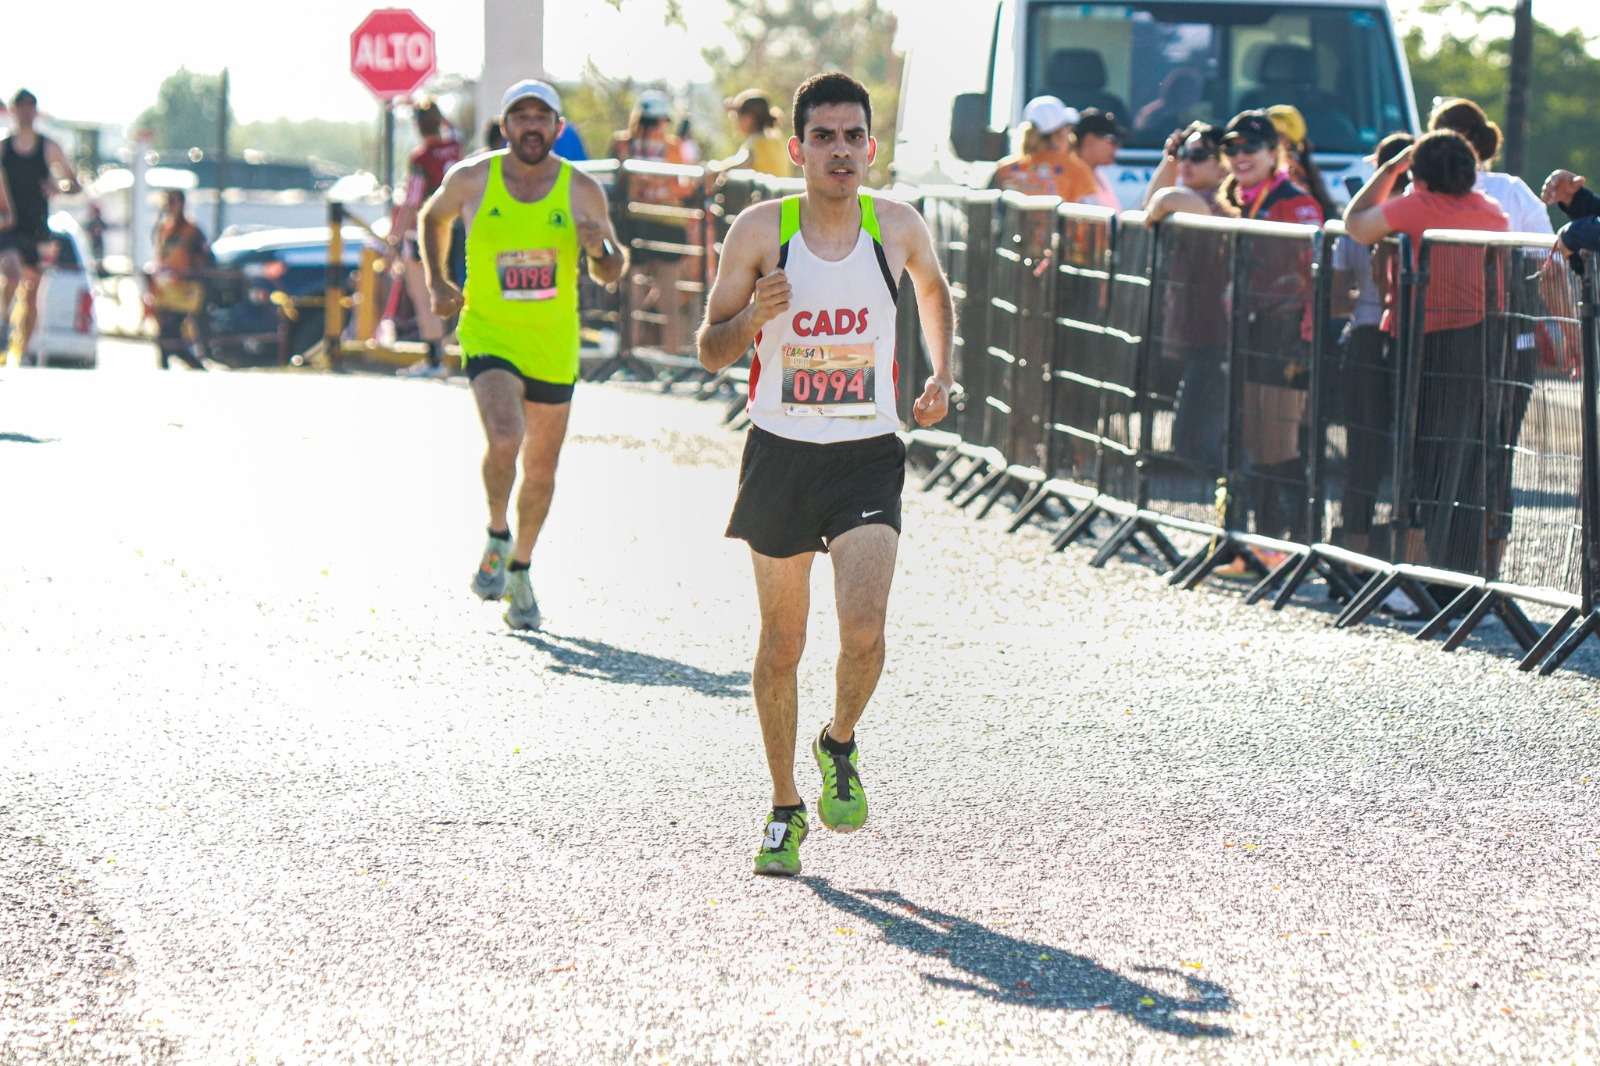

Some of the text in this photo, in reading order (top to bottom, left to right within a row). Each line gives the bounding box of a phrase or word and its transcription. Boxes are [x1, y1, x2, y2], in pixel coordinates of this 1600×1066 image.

[355, 32, 431, 70] ALTO
[505, 266, 552, 289] 0198
[792, 307, 869, 337] CADS
[793, 368, 865, 401] 0994
